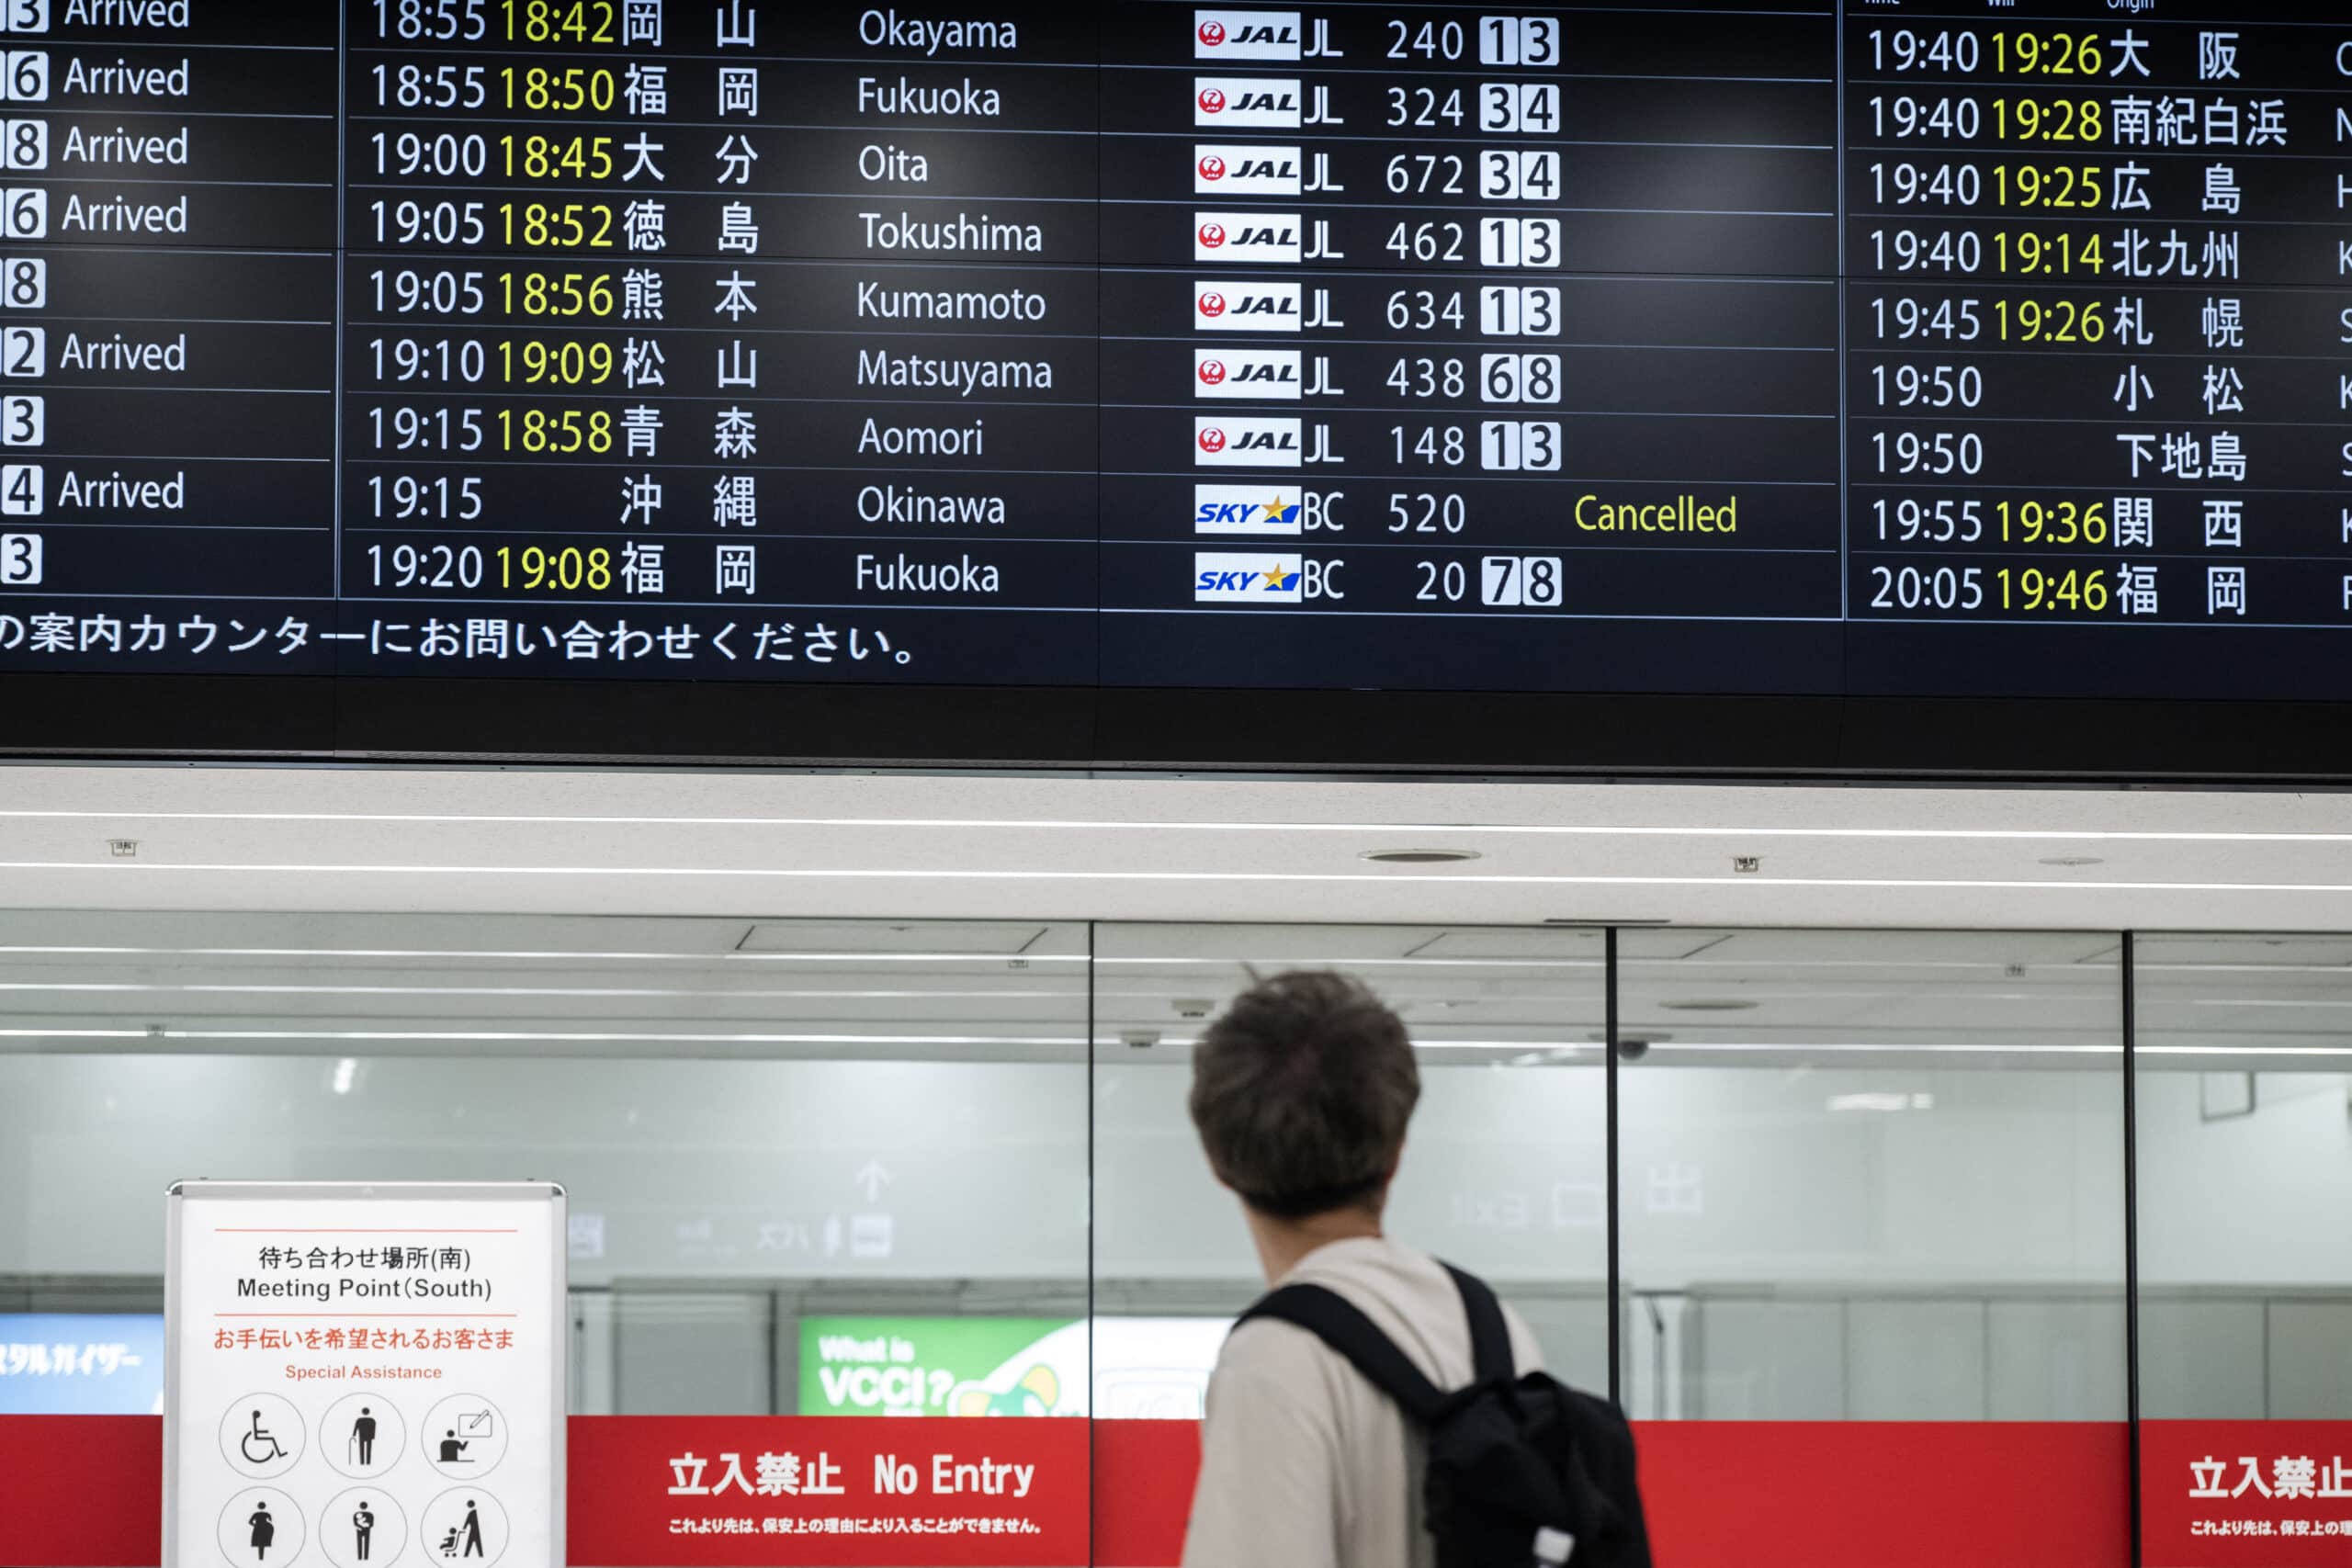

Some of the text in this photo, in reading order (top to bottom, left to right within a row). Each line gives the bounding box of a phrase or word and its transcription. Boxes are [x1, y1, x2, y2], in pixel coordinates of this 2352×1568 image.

[17, 0, 188, 28] 3 Arrived
[374, 0, 485, 39] 18:55
[503, 0, 613, 42] 18:42
[860, 9, 1015, 56] Okayama
[1231, 27, 1297, 43] JAL
[1304, 19, 1343, 56] JL
[1387, 20, 1463, 60] 240
[1870, 30, 1978, 72] 19:40
[1993, 33, 2101, 74] 19:26
[15, 55, 187, 97] 6 Arrived
[373, 65, 484, 107] 18:55
[502, 68, 614, 110] 18:50
[859, 77, 1000, 115] Fukuoka
[1231, 94, 1297, 110] JAL
[1304, 86, 1343, 123] JL
[1387, 87, 1464, 126] 324
[1871, 95, 2287, 146] 19:40 19:28 南紀白浜
[14, 123, 187, 165] 8 Arrived
[372, 133, 485, 175] 19:00
[501, 136, 611, 178] 18:45
[859, 145, 927, 181] Oita
[1231, 161, 1297, 178] JAL
[1304, 153, 1343, 191] JL
[1387, 154, 1463, 193] 672
[1871, 164, 1979, 205] 19:40
[1994, 166, 2100, 207] 19:25
[13, 192, 187, 234] 6 Arrived
[372, 201, 483, 243] 19:05
[501, 204, 612, 246] 18:52
[859, 212, 1041, 251] Tokushima
[1231, 228, 1297, 245] JAL
[1305, 220, 1343, 258] JL
[1386, 222, 1463, 261] 462
[1871, 229, 2238, 279] 19:40 19:14 北九州
[12, 262, 38, 304] 8
[371, 271, 483, 313] 19:05
[500, 273, 613, 315] 18:56
[859, 282, 1046, 320] Kumamoto
[1231, 297, 1297, 314] JAL
[1305, 289, 1343, 327] JL
[1387, 291, 1464, 329] 634
[1872, 299, 1979, 340] 19:45
[1996, 300, 2104, 342] 19:26
[11, 331, 185, 373] 2 Arrived
[370, 339, 483, 381] 19:10
[500, 342, 612, 384] 19:09
[858, 350, 1051, 397] Matsuyama
[1231, 365, 1297, 382] JAL
[1305, 357, 1343, 394] JL
[1386, 358, 1464, 397] 438
[1872, 366, 1981, 407] 19:50
[11, 400, 34, 442] 3
[370, 408, 481, 450] 19:15
[499, 410, 611, 452] 18:58
[858, 419, 982, 455] Aomori
[1231, 433, 1298, 449] JAL
[1305, 424, 1344, 462] JL
[1392, 426, 1464, 465] 148
[1873, 431, 2246, 480] 19:50 下地島
[8, 468, 183, 512] 4 Arrived
[369, 477, 481, 519] 19:15
[858, 485, 1004, 523] Okinawa
[1195, 503, 1260, 523] SKY
[1305, 492, 1343, 530] BC
[1389, 494, 1464, 533] 520
[1576, 495, 1736, 532] Cancelled
[1873, 500, 1981, 541] 19:55
[1997, 502, 2106, 543] 19:36
[9, 537, 32, 581] 3
[368, 545, 482, 588] 19:20
[498, 547, 610, 590] 19:08
[857, 554, 998, 592] Fukuoka
[1195, 571, 1260, 591] SKY
[1305, 559, 1344, 599] BC
[1417, 561, 1464, 601] 20
[1871, 567, 1982, 608] 20:05
[1998, 569, 2107, 610] 19:46
[259, 1247, 469, 1271] 待ち合わせ場所(南)
[238, 1279, 329, 1301] Meeting
[215, 1328, 513, 1349] お手伝いを希望されるお客さま
[819, 1337, 915, 1362] What is
[287, 1365, 441, 1382] Special Assistance
[668, 1452, 1034, 1497] 立入禁止 No Entry
[2188, 1456, 2352, 1499] 立入禁止
[670, 1517, 1040, 1533] これより先は、保安上の理由により入ることができません。
